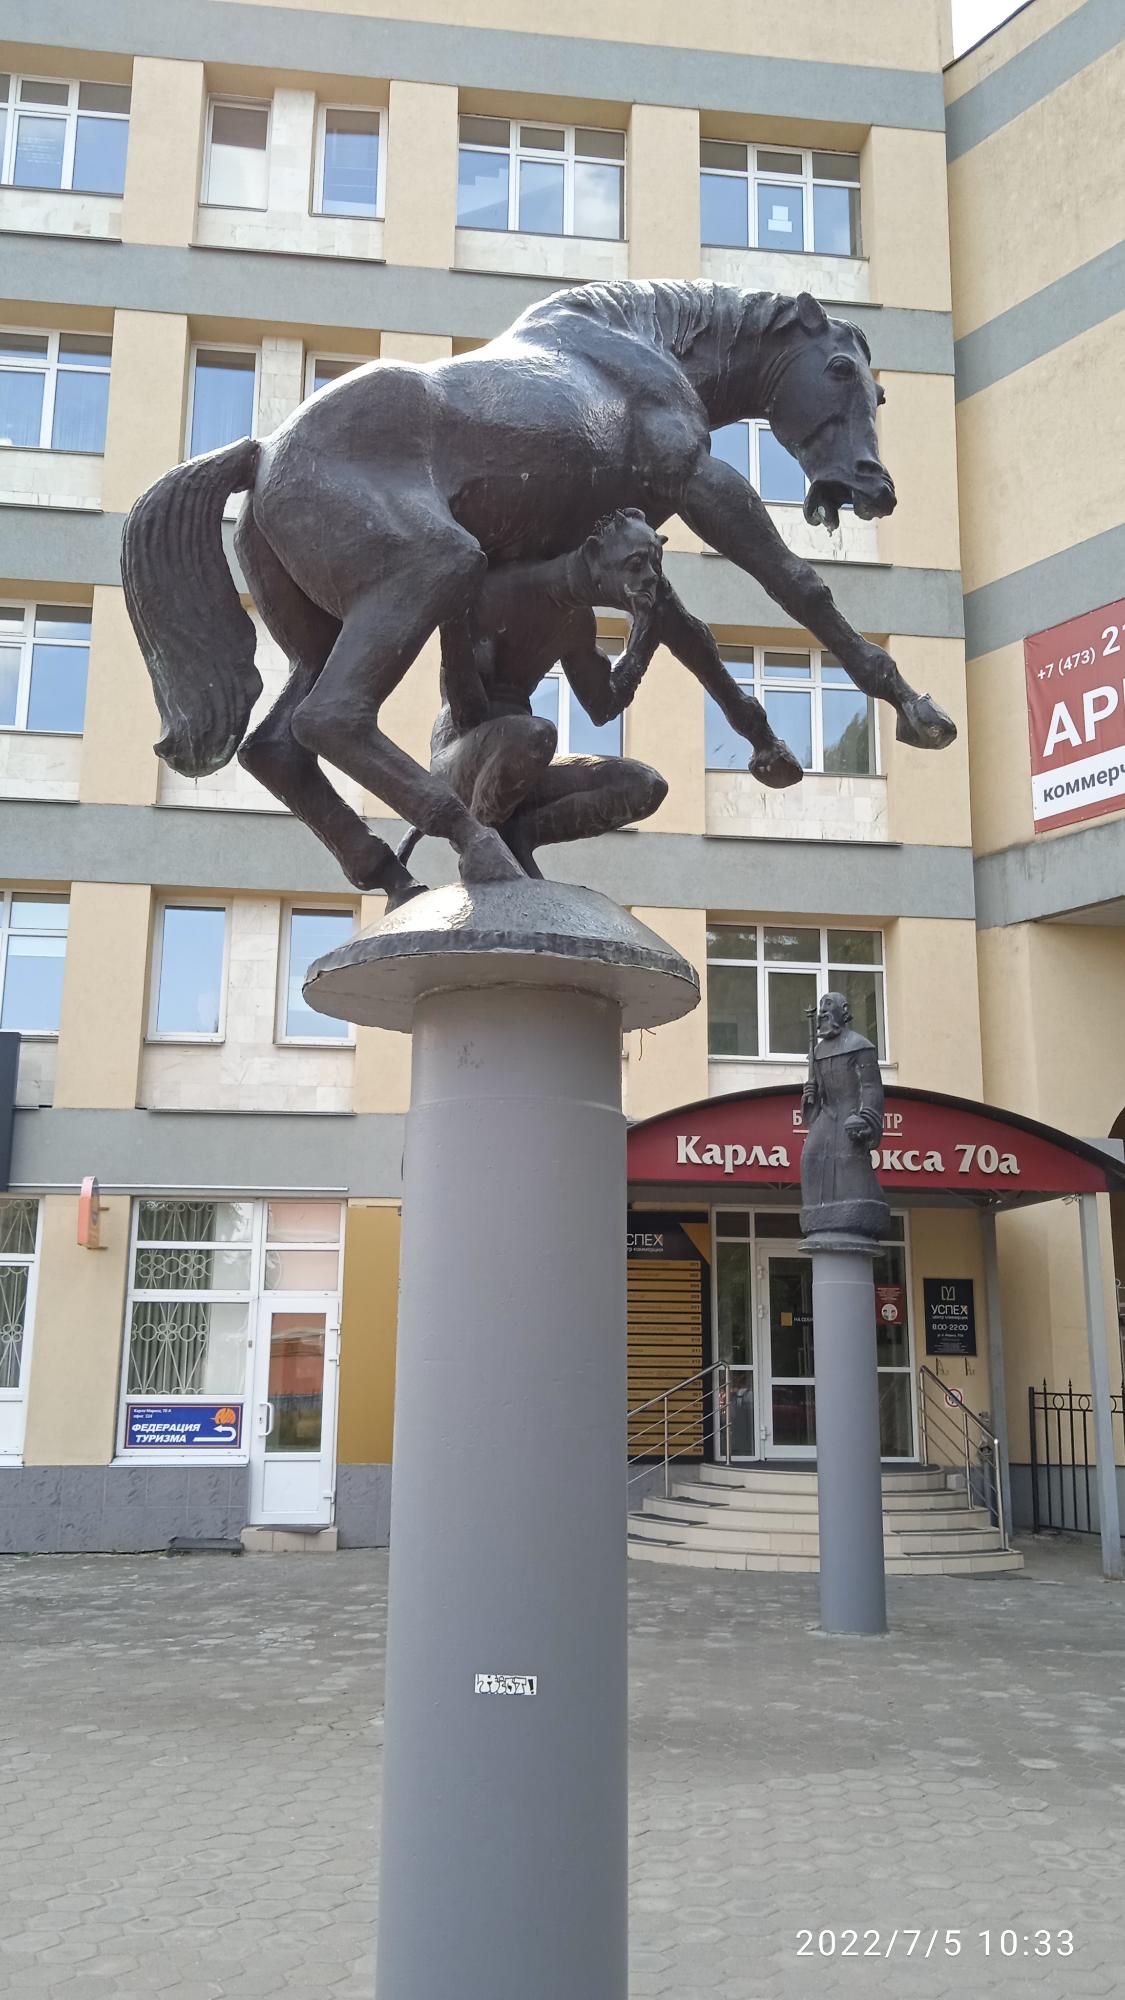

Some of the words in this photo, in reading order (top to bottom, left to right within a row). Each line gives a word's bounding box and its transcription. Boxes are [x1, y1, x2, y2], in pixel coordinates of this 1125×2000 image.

[1037, 663, 1054, 680] +7
[1058, 647, 1096, 677] (473)
[1042, 677, 1125, 758] АР
[676, 1135, 790, 1173] Карла
[954, 1144, 1021, 1175] 70а
[626, 1233, 664, 1247] СПЕХ
[931, 1304, 968, 1315] УСПЕХ
[132, 1423, 201, 1433] ФЕДЕРАЦИЯ
[135, 1434, 186, 1443] ТУРИЗМА
